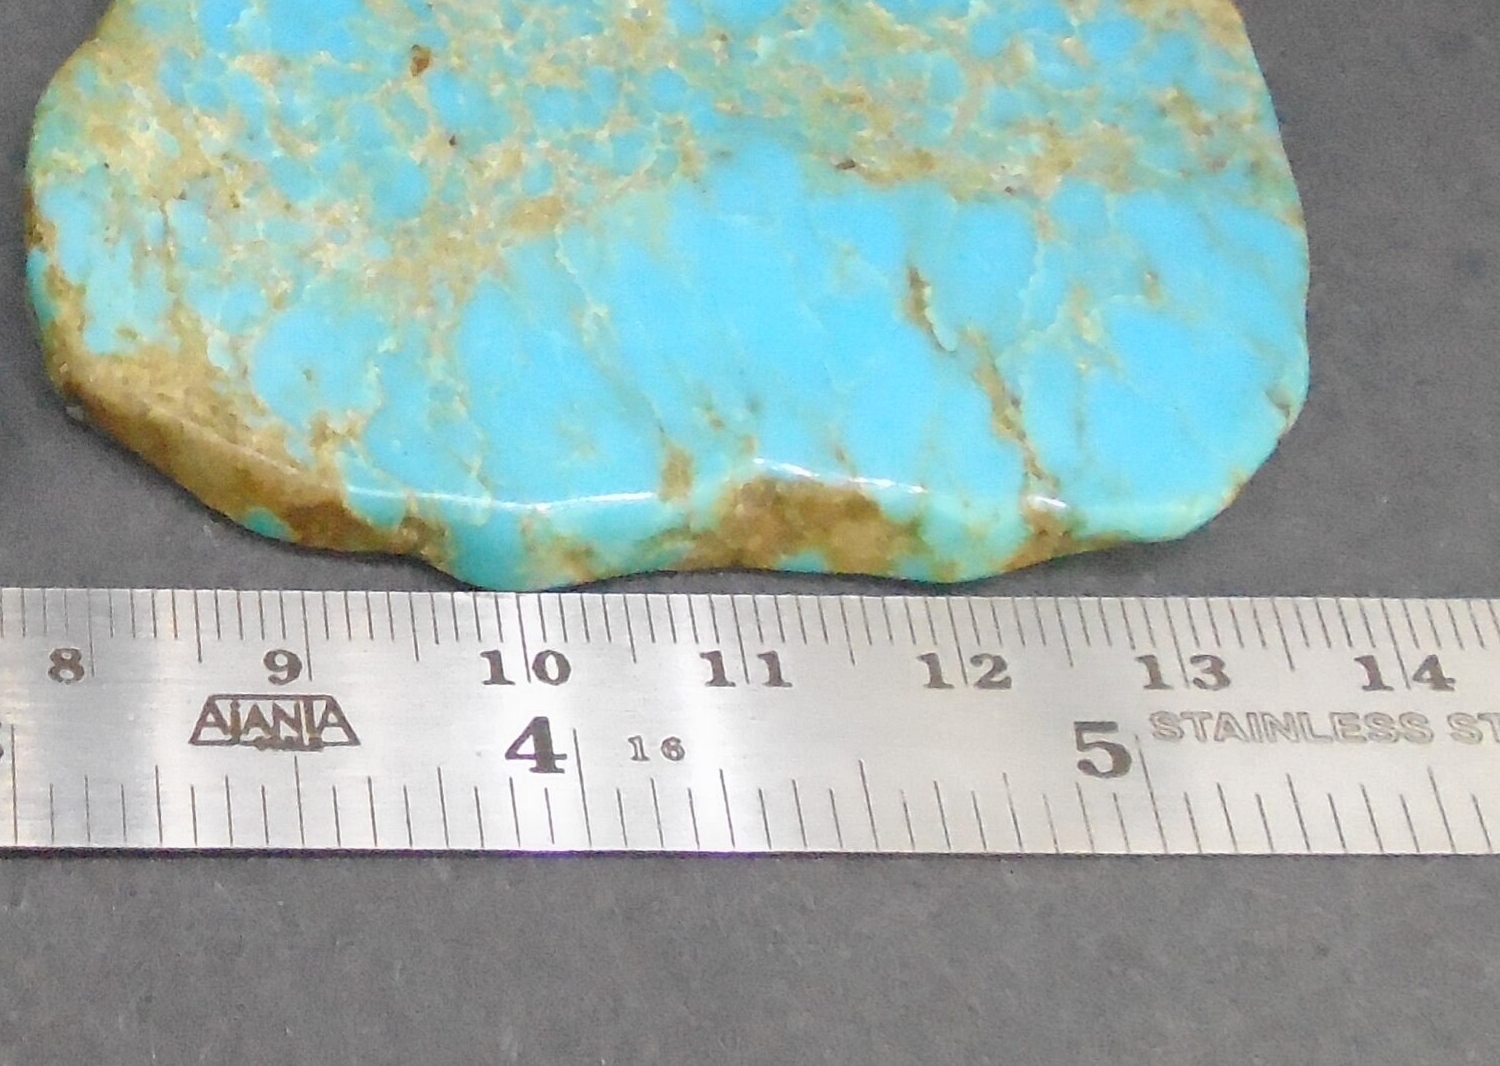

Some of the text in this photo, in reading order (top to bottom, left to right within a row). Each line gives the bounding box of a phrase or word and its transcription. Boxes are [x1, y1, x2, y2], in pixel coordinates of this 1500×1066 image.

[48, 647, 85, 685] 8
[263, 649, 301, 686] 9
[480, 649, 572, 686] 10
[700, 650, 793, 688] 11
[918, 653, 1012, 690] 12
[1136, 653, 1231, 691] 13
[1355, 654, 1456, 692] 14
[504, 715, 568, 774] 4
[1149, 710, 1435, 745] STAINLESS
[628, 735, 686, 763] 16
[1073, 720, 1133, 779] 5
